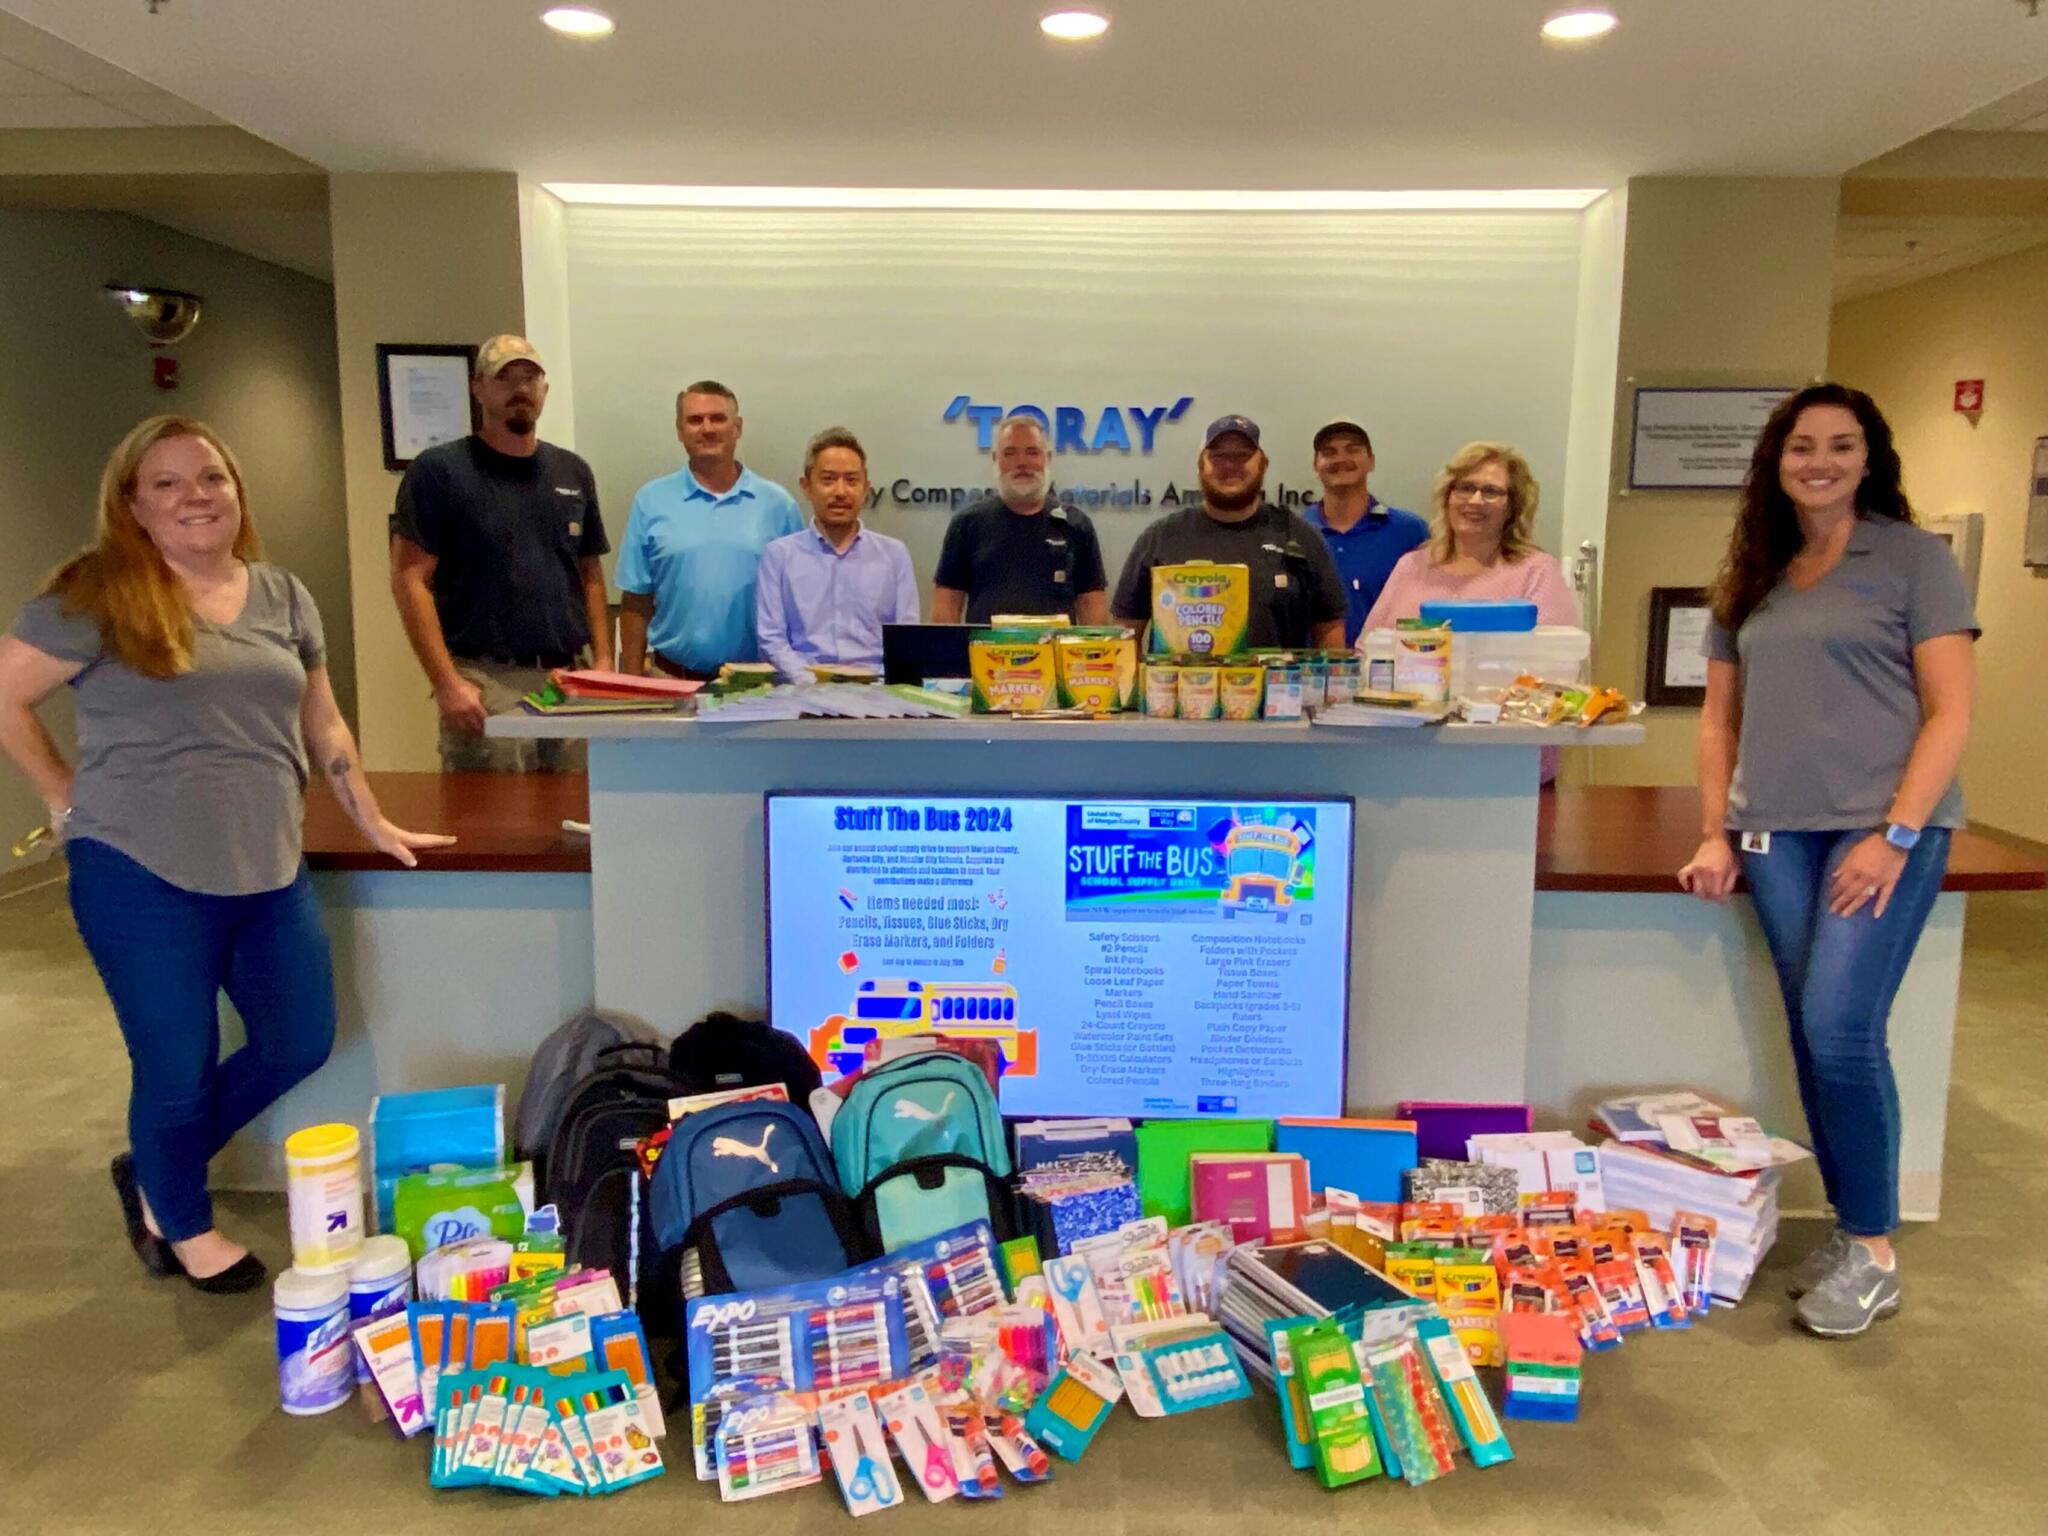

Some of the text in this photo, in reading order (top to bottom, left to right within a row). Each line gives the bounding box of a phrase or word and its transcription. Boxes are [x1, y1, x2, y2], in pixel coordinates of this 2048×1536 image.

[891, 478, 997, 511] Compos
[1176, 604, 1224, 615] COLORED
[834, 806, 1013, 832] Stuff The Bus 2024
[1069, 844, 1213, 877] STUFF THE BUS
[1080, 876, 1124, 887] SCHOOL
[1127, 876, 1167, 888] SUPPLY
[867, 895, 980, 911] Items needed most:
[838, 915, 1009, 932] Pencils, Tissues, Glue Sticks, Dry
[853, 934, 995, 950] Erase Markers, and Folders
[1089, 932, 1160, 943] Safety Scissors
[1192, 934, 1306, 945] Composition Notebooks
[1101, 944, 1148, 953] #2 Pencils
[1200, 945, 1235, 954] Folders
[1237, 946, 1257, 955] with
[1105, 955, 1144, 964] Ink Pens
[1205, 957, 1292, 968] Large Pink Erasers
[1084, 965, 1164, 976] Spiral Notebooks
[1218, 967, 1247, 976] Tissue
[1084, 977, 1164, 988] Loose Leaf Paper
[1216, 979, 1279, 989] Paper Towels
[1105, 988, 1142, 997] Markers
[1213, 990, 1282, 999] Hand Sanitizer
[1095, 999, 1123, 1008] Pencil
[1127, 1021, 1165, 1032] Crayons
[1207, 1022, 1288, 1034] Plain Copy Paper
[1073, 1032, 1124, 1041] Watercolor
[1128, 1066, 1166, 1074] Markers
[1218, 1067, 1275, 1079] Highlighters
[1086, 1075, 1124, 1085] Colored
[691, 1299, 757, 1334] EXPO
[725, 1405, 770, 1432] EXPO
